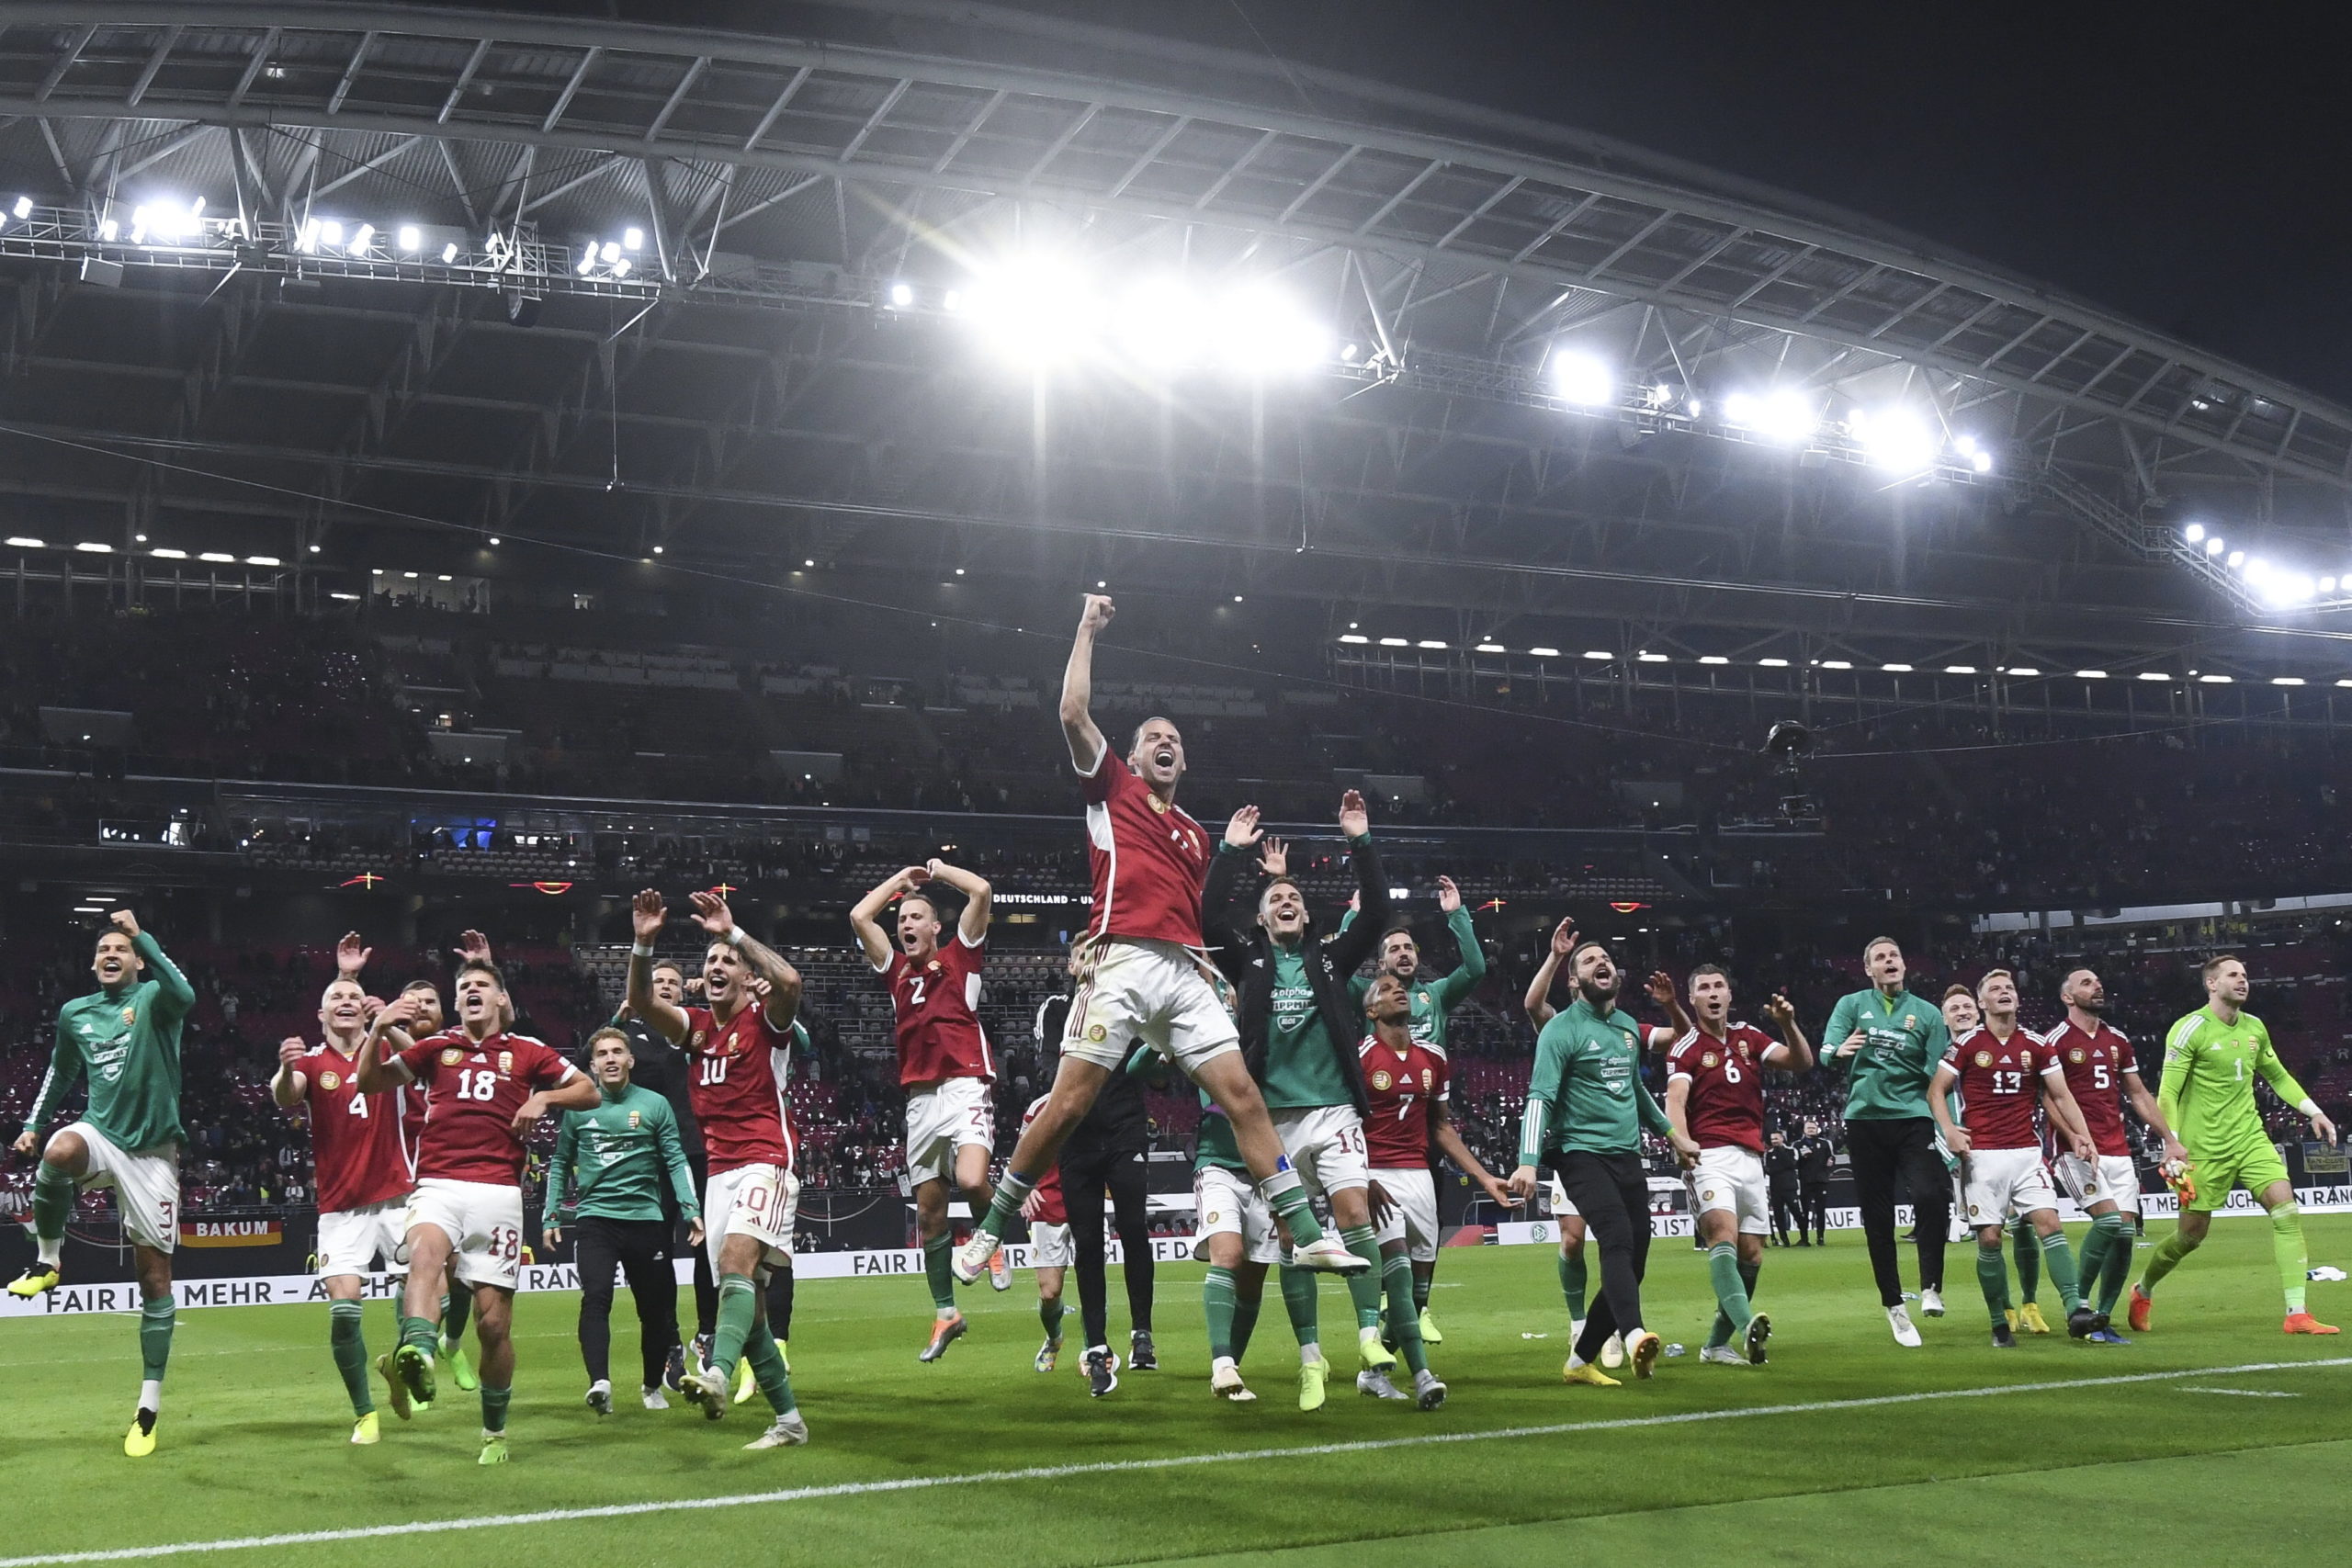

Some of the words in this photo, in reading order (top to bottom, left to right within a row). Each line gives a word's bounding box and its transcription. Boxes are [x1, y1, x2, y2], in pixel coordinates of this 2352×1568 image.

[993, 894, 1069, 904] DEUTSCHLAND
[1080, 896, 1094, 905] UN
[910, 976, 925, 1004] 2
[700, 1056, 728, 1086] 10
[1724, 1058, 1741, 1083] 6
[2094, 1065, 2110, 1089] 5
[2234, 1058, 2244, 1081] 1
[458, 1068, 497, 1101] 18
[1993, 1071, 2021, 1094] 13
[348, 1092, 368, 1119] 4
[968, 1107, 984, 1126] 2
[1398, 1094, 1414, 1121] 7
[1335, 1127, 1364, 1155] 16
[2223, 1193, 2256, 1209] UCH
[159, 1201, 173, 1228] 3
[1664, 1218, 1690, 1236] IST
[196, 1220, 269, 1237] BAKUM
[488, 1226, 518, 1260] 18
[854, 1253, 907, 1274] FAIR
[46, 1288, 116, 1313] FAIR
[185, 1281, 272, 1306] MEHR
[308, 1276, 390, 1301] AH
